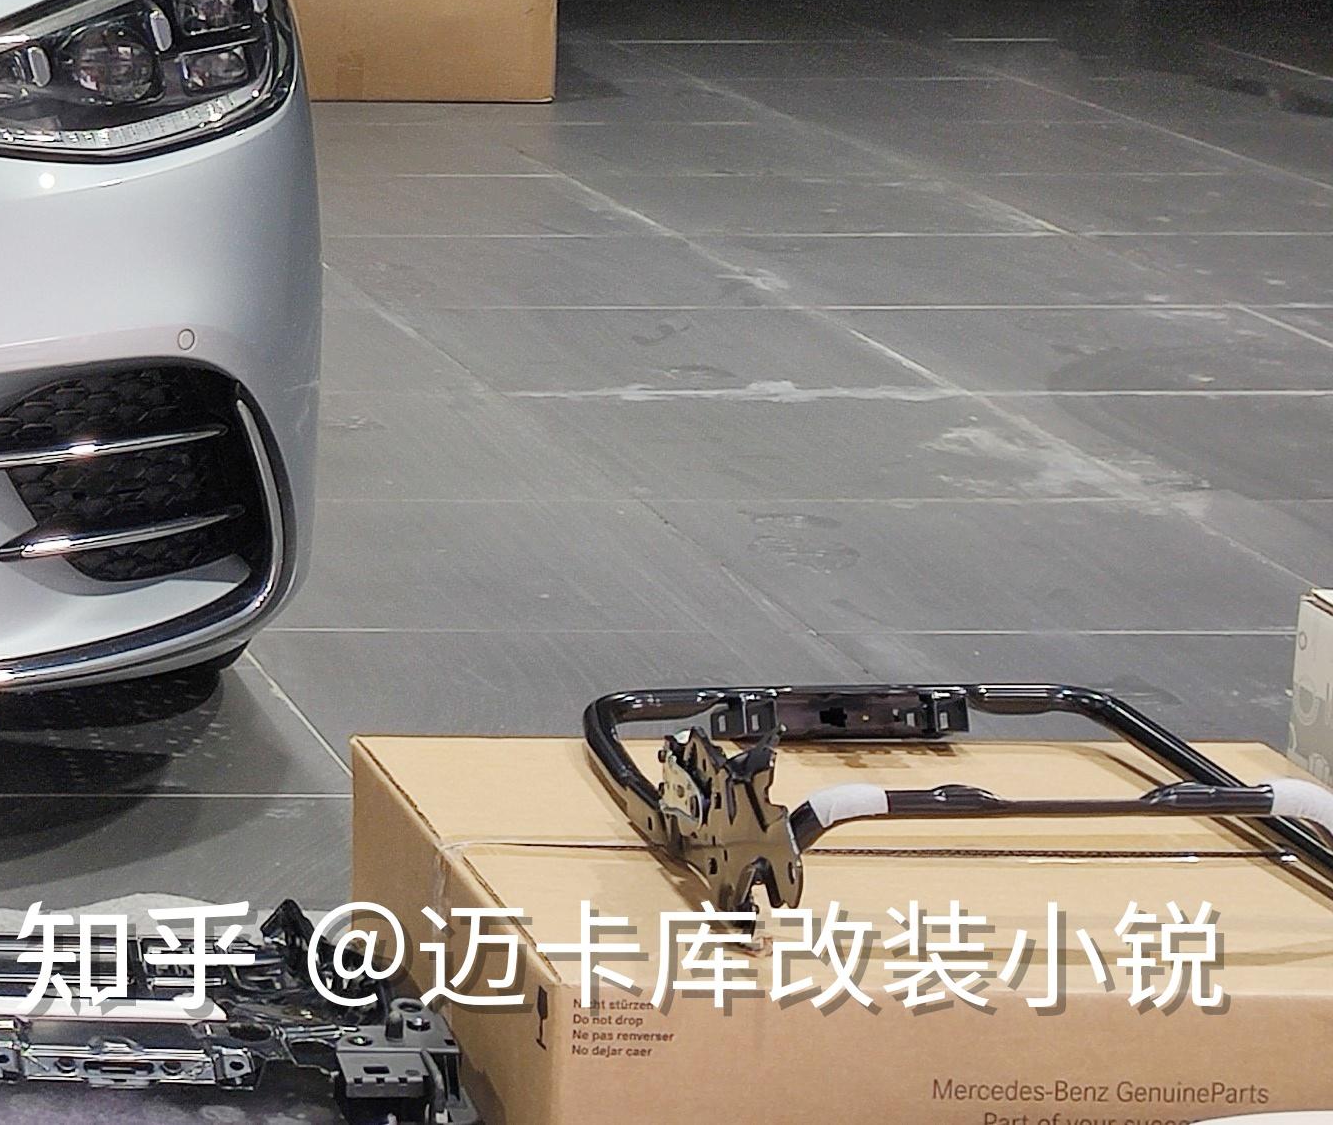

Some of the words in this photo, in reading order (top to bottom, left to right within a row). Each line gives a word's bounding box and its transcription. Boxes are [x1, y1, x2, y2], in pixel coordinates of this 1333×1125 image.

[573, 998, 605, 1009] Nht
[573, 1014, 589, 1025] Do
[592, 1015, 612, 1025] not
[615, 1015, 644, 1027] drop
[573, 1029, 589, 1040] Ne
[593, 1031, 614, 1042] pas
[617, 1031, 674, 1041] renverser
[572, 1044, 588, 1055] No
[592, 1046, 623, 1058] dejar
[625, 1047, 653, 1056] caer
[932, 1078, 1109, 1102] Mercedes-Benz
[1116, 1081, 1270, 1104] GenuineParts
